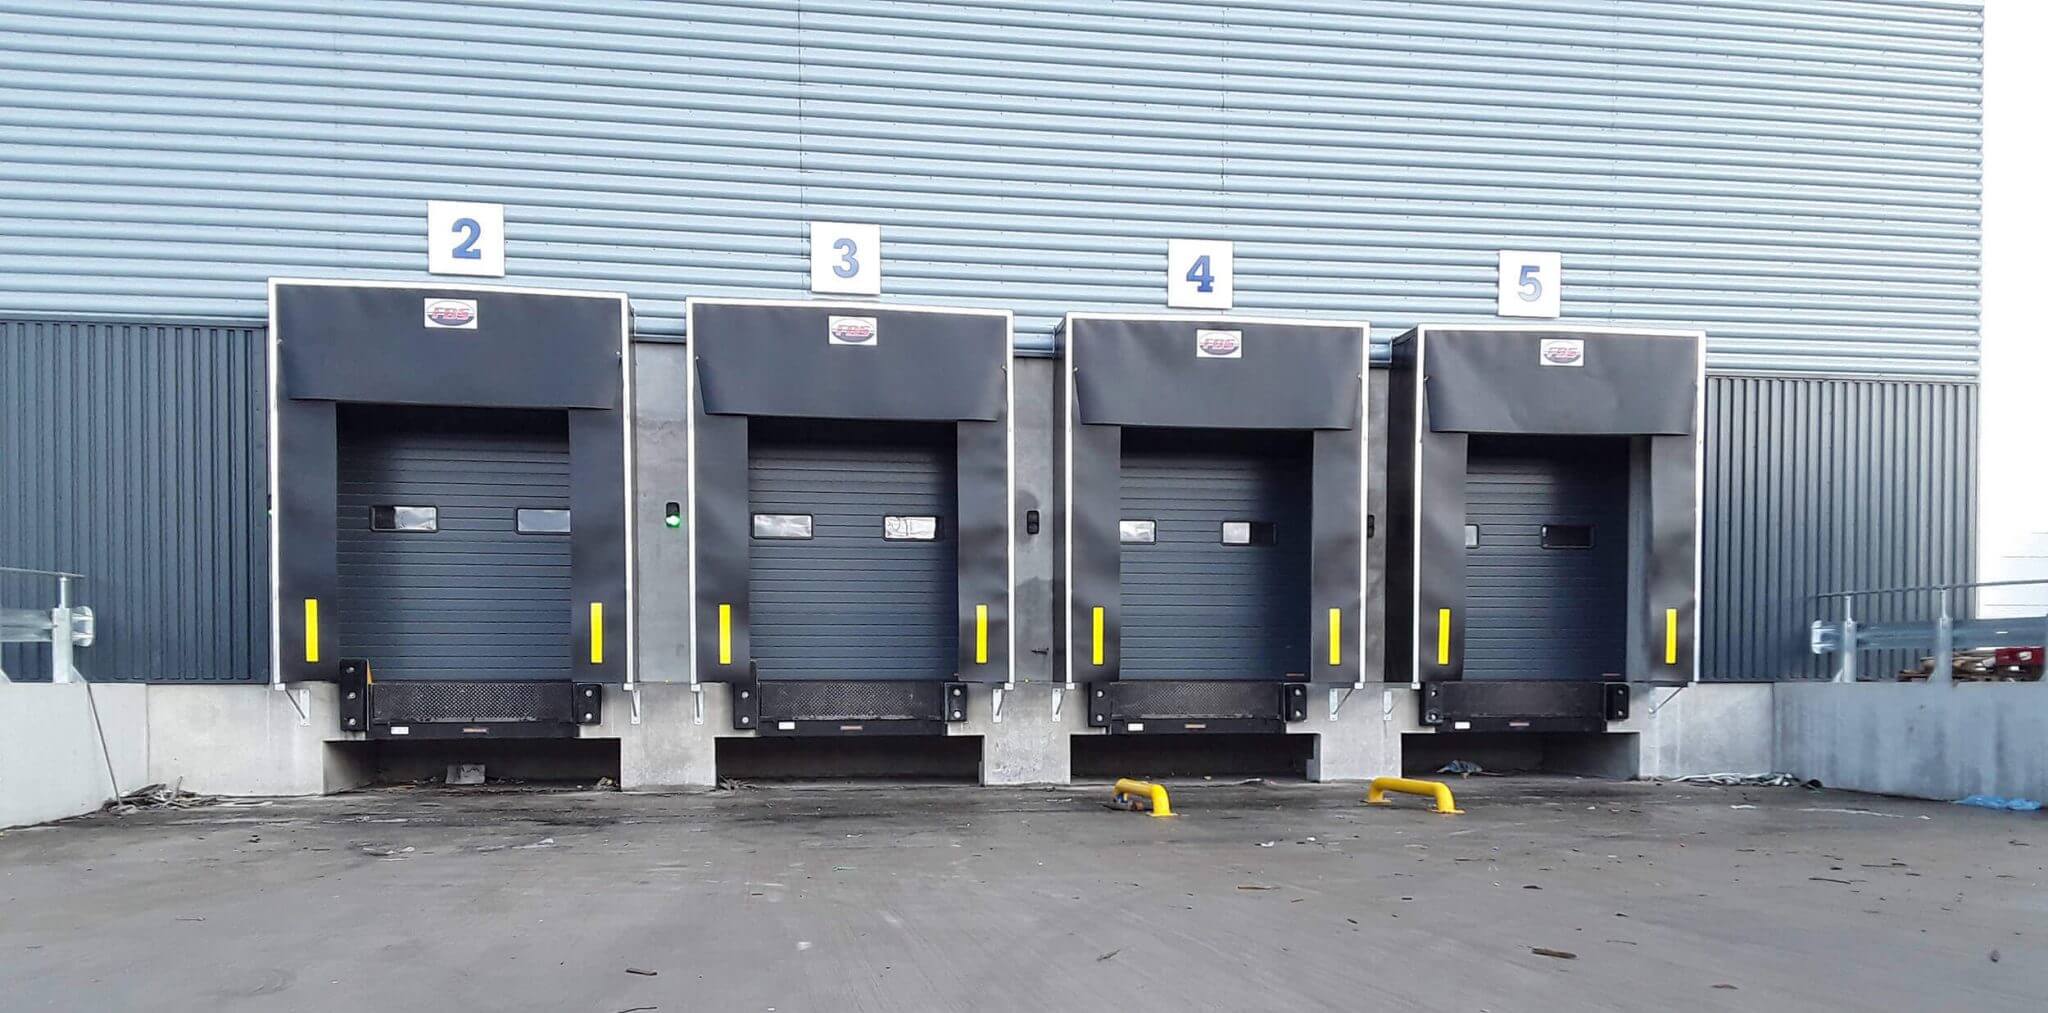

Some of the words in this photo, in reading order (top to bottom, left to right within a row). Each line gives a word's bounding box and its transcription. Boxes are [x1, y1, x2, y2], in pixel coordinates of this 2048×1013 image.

[451, 217, 482, 260] 2
[832, 237, 860, 279] 3
[1186, 255, 1215, 293] 4
[1518, 265, 1543, 302] 5
